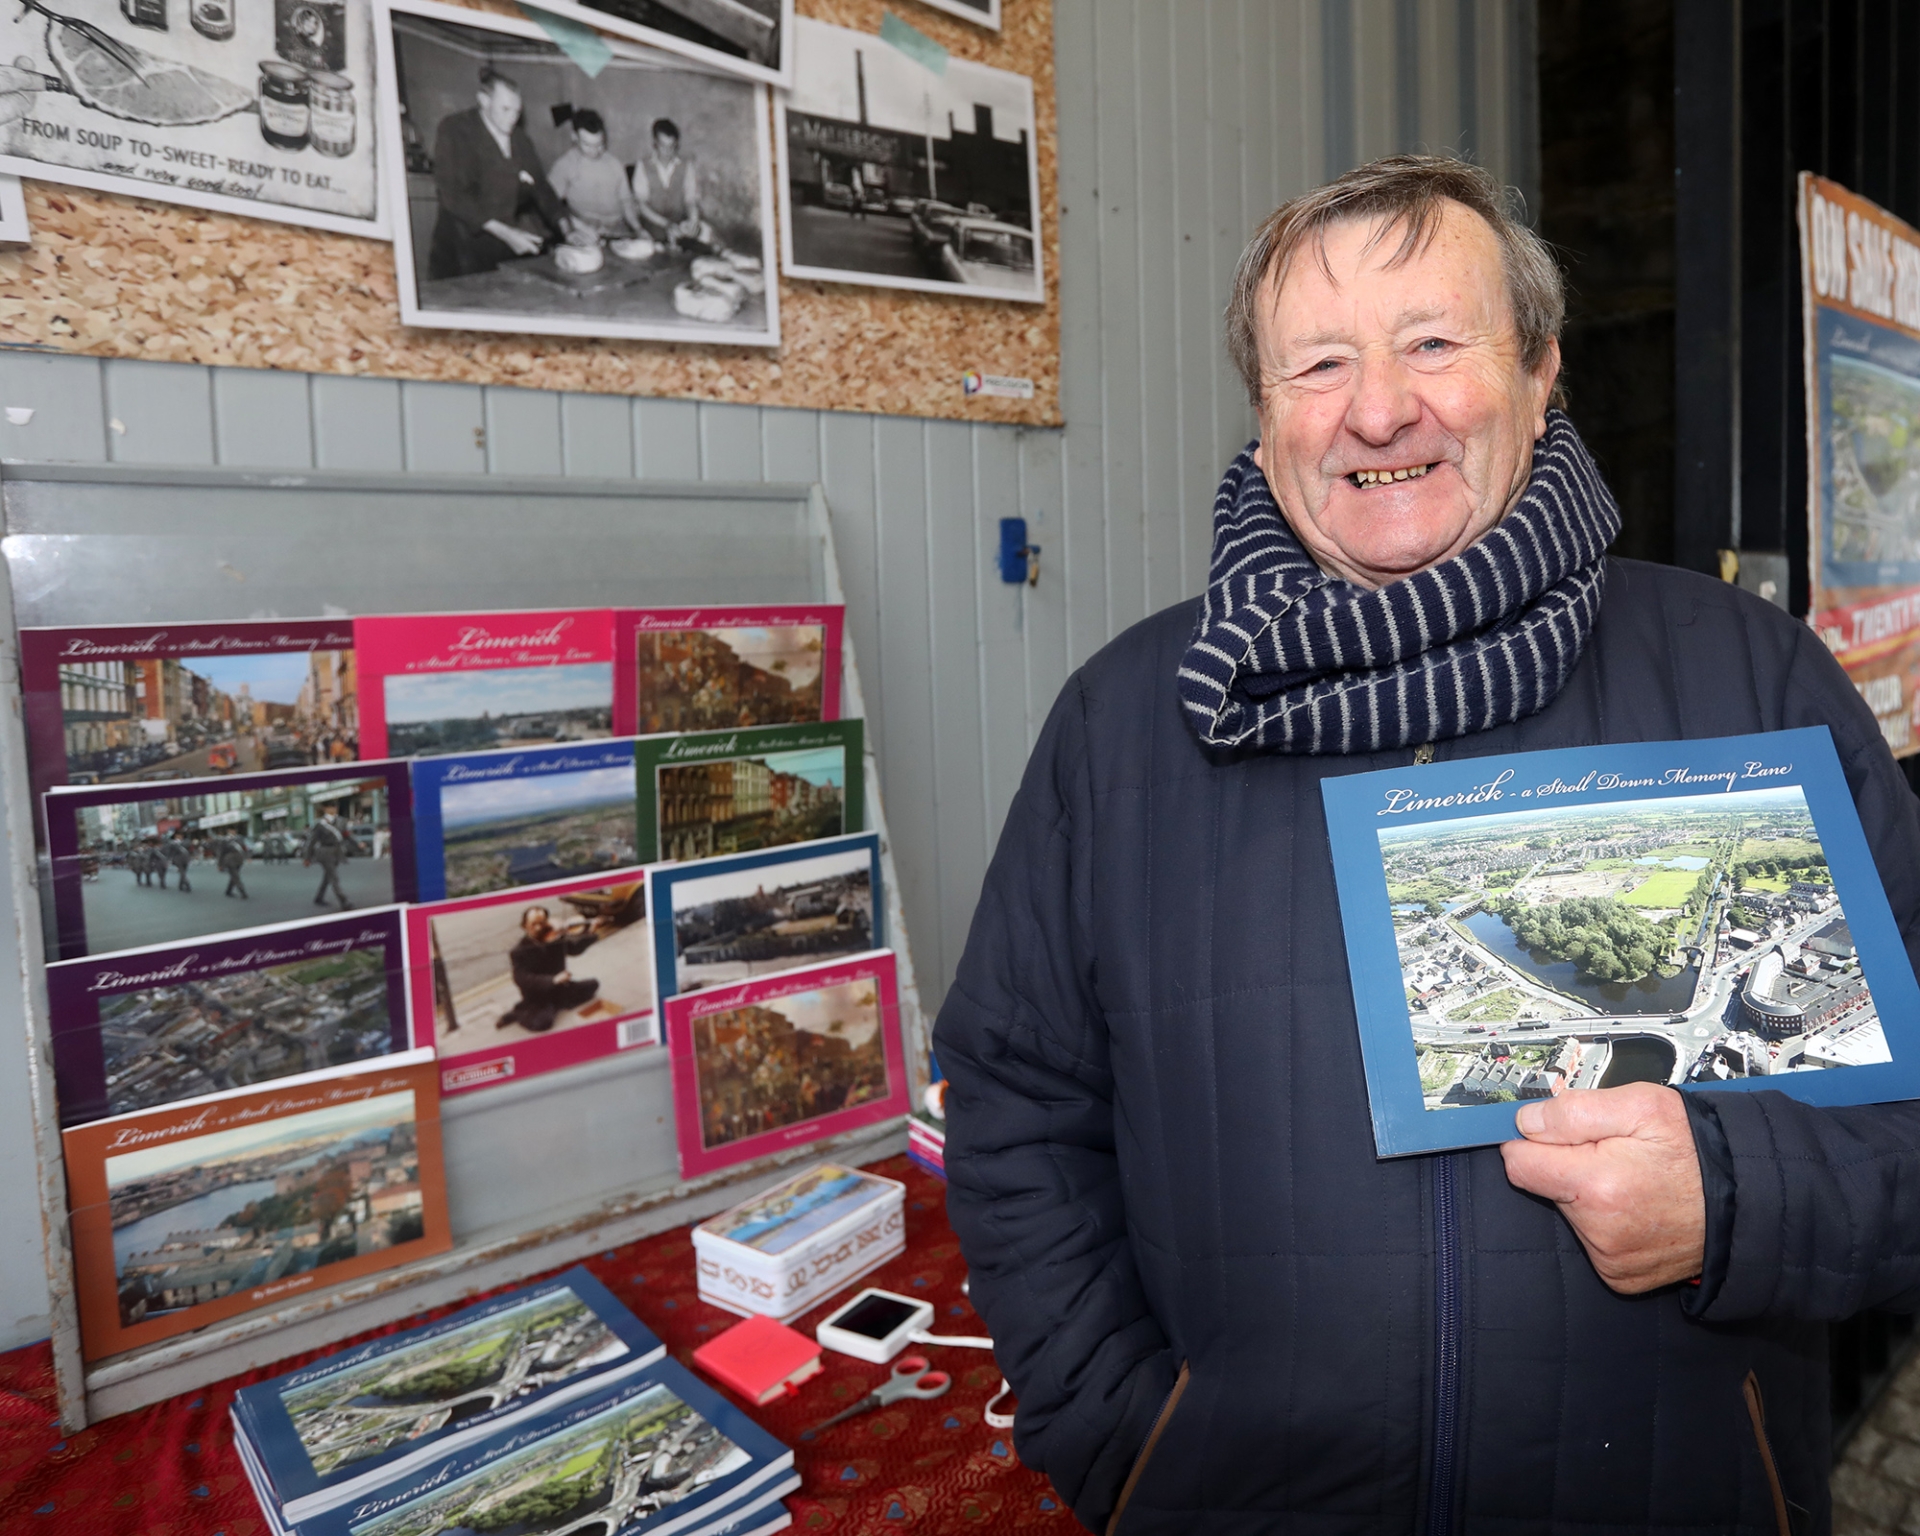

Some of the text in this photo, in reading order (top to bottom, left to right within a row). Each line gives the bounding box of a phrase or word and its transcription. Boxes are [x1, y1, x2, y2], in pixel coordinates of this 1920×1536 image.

[22, 118, 70, 142] FROM
[77, 129, 122, 151] SOUP
[282, 168, 302, 185] TO
[101, 162, 139, 175] and
[59, 632, 168, 656] Limerick
[448, 617, 574, 651] Limerick
[659, 734, 738, 760] Limerick
[441, 754, 523, 782] Limerick
[1376, 768, 1515, 816] Limerick
[1521, 789, 1533, 798] a
[1536, 770, 1597, 798] Stroll
[1596, 773, 1655, 790] Down
[1658, 767, 1738, 793] Memory
[1741, 761, 1793, 779] Lane
[87, 953, 199, 992] Limerick
[106, 1106, 218, 1150] Limerick
[279, 1342, 380, 1391] Limerick
[347, 1460, 457, 1524] Limerick
